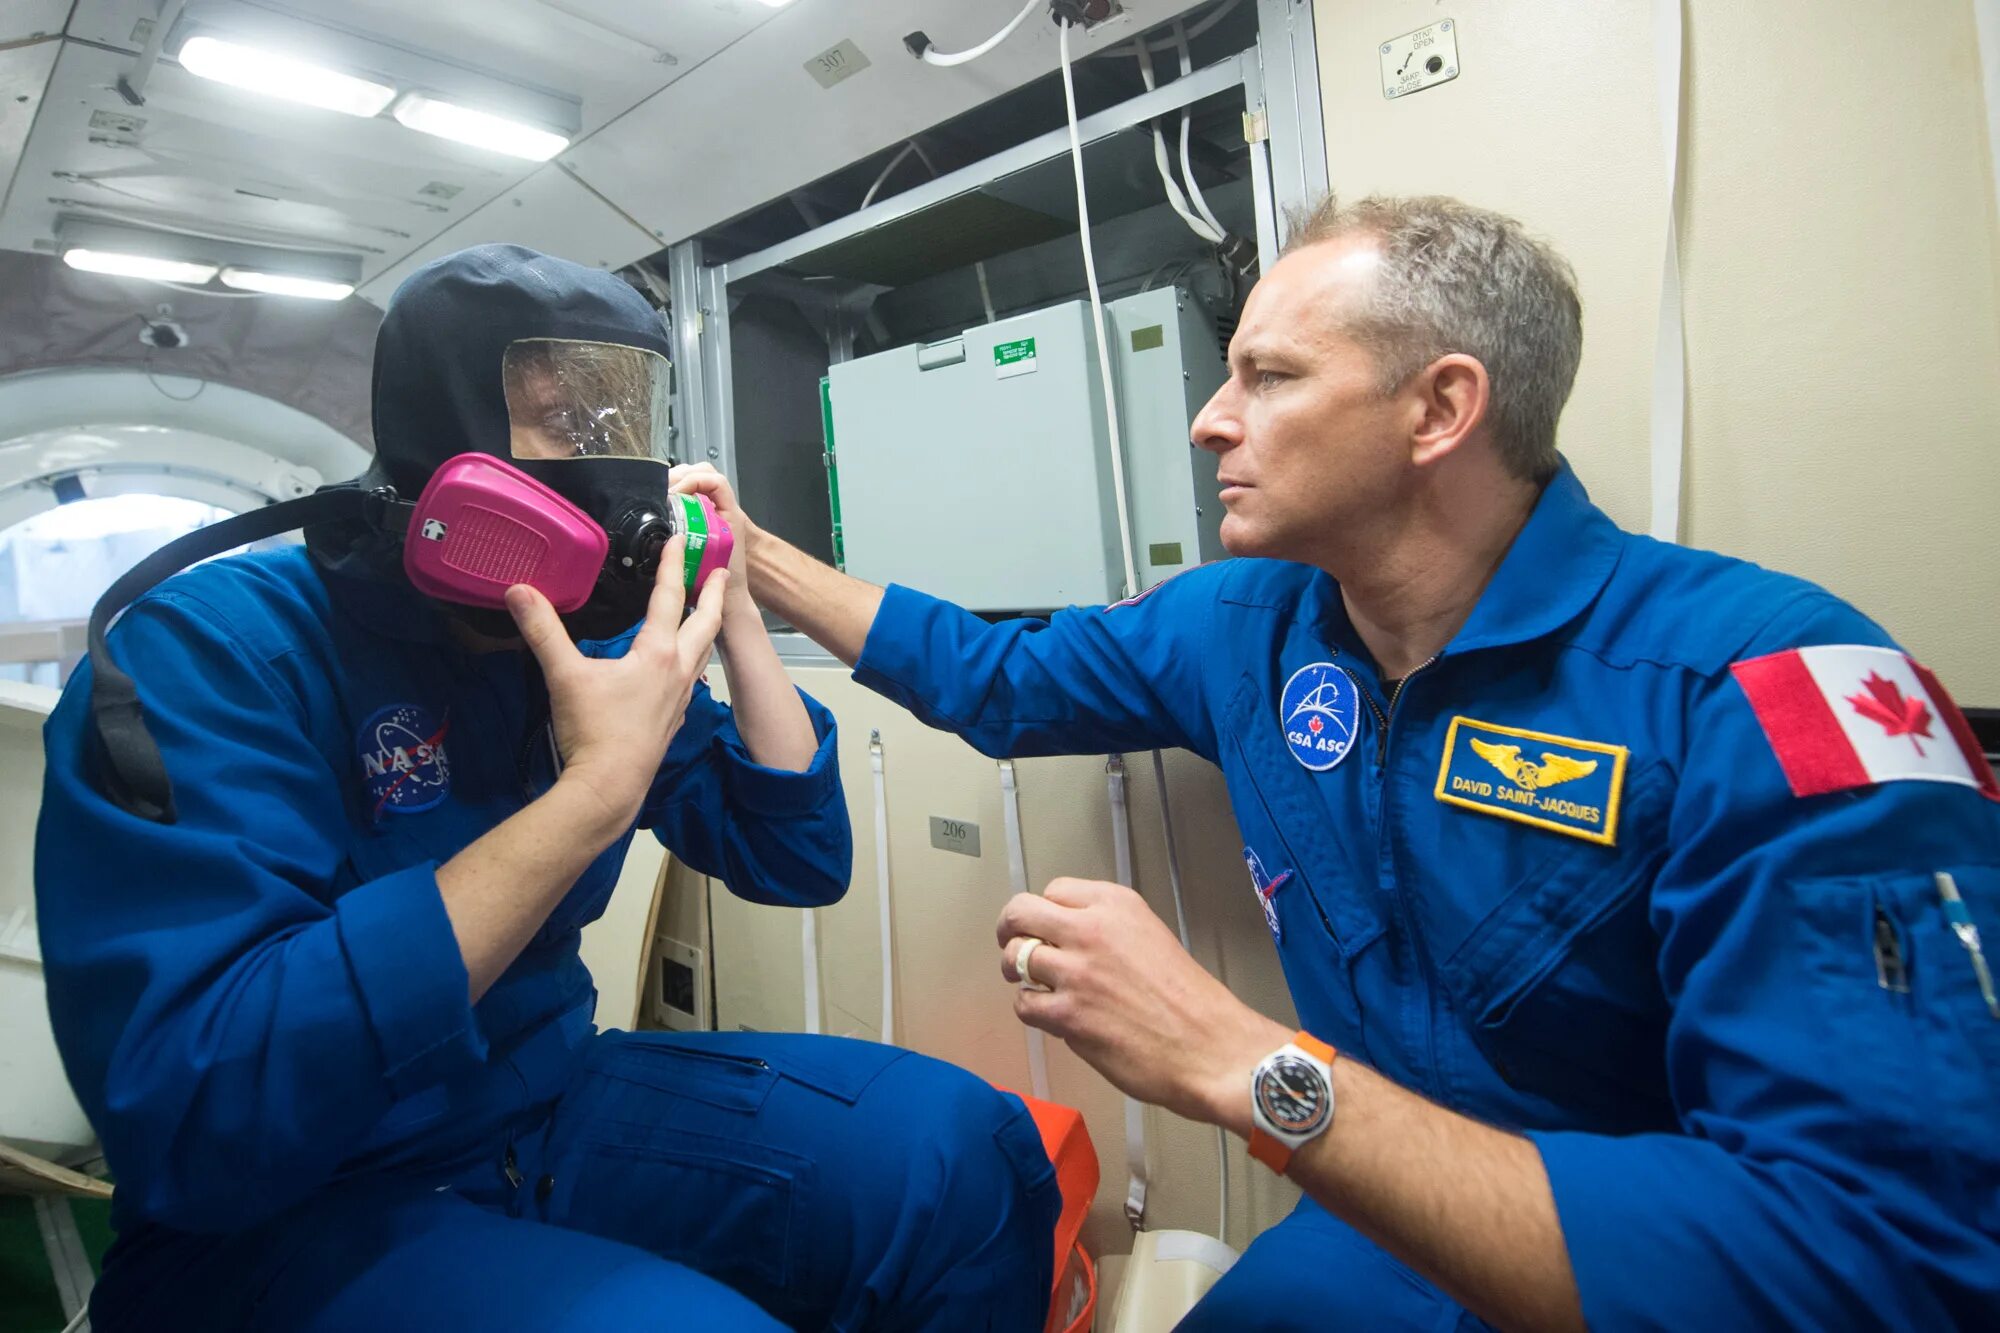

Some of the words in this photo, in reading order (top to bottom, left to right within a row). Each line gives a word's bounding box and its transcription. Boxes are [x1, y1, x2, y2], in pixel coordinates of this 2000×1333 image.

[1413, 36, 1435, 50] OPEN
[817, 49, 846, 72] 307
[1397, 79, 1422, 94] CLOSE
[1288, 731, 1312, 748] CSA
[1315, 738, 1346, 753] ASC
[361, 744, 449, 779] NASA
[1452, 776, 1492, 797] DAVID
[1496, 785, 1600, 823] SAINT-JACQUES
[942, 819, 966, 840] 206
